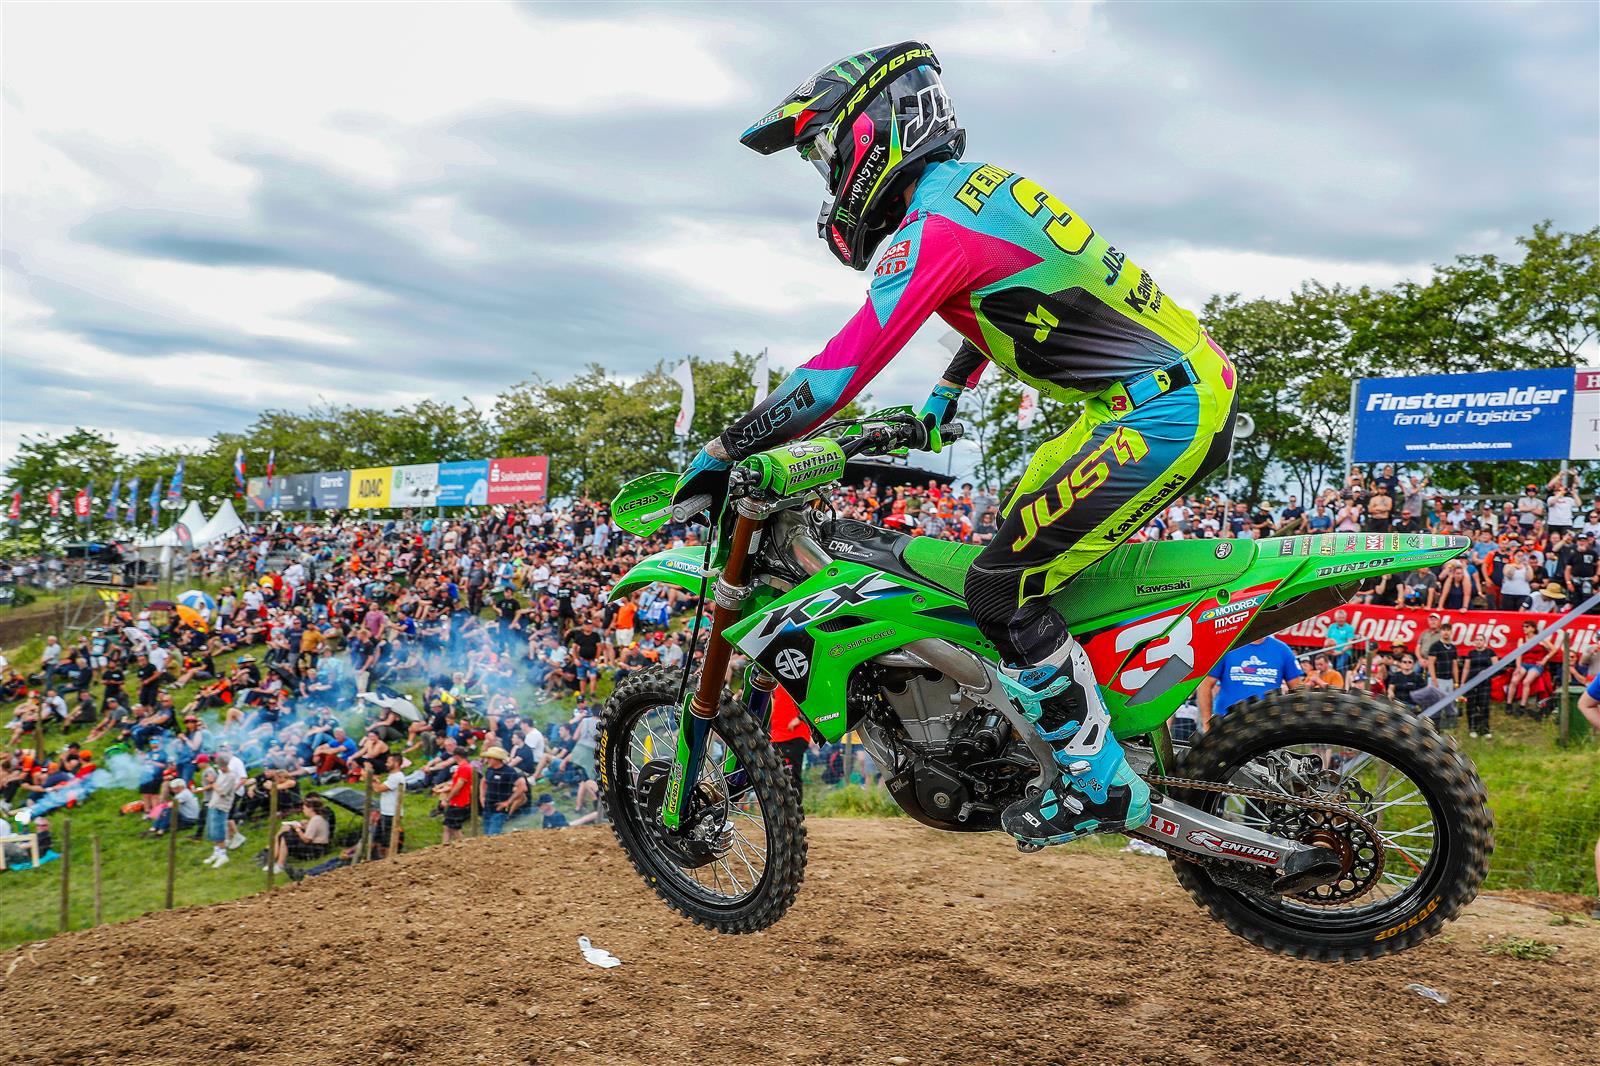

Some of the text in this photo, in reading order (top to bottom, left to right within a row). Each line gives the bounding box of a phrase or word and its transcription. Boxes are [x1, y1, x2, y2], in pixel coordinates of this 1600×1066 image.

[848, 144, 886, 204] MONSTER
[953, 163, 1017, 216] FEB
[1010, 176, 1095, 255] 3
[1111, 396, 1128, 411] 3
[1366, 386, 1568, 411] Finsterwalder
[736, 378, 816, 449] JUST1
[1393, 411, 1442, 427] family
[1444, 410, 1465, 424] of
[1405, 441, 1512, 451] www.finsterwalder.com
[788, 451, 841, 473] RENTHAL
[790, 463, 841, 485] RENTHAL
[357, 478, 383, 498] ADAC
[1012, 425, 1150, 552] JUST1
[617, 494, 659, 514] ACERBIS
[1102, 474, 1187, 544] Kawasaki
[829, 540, 853, 554] CRM
[1318, 557, 1395, 577] DUNLOP
[1136, 580, 1191, 594] Kawasaki
[758, 572, 884, 639] KX
[1215, 597, 1259, 617] MOTOREX
[1214, 611, 1250, 629] MXGP
[1279, 616, 1331, 637] uis
[1115, 614, 1195, 690] 3
[600, 729, 609, 791] DUNLOP
